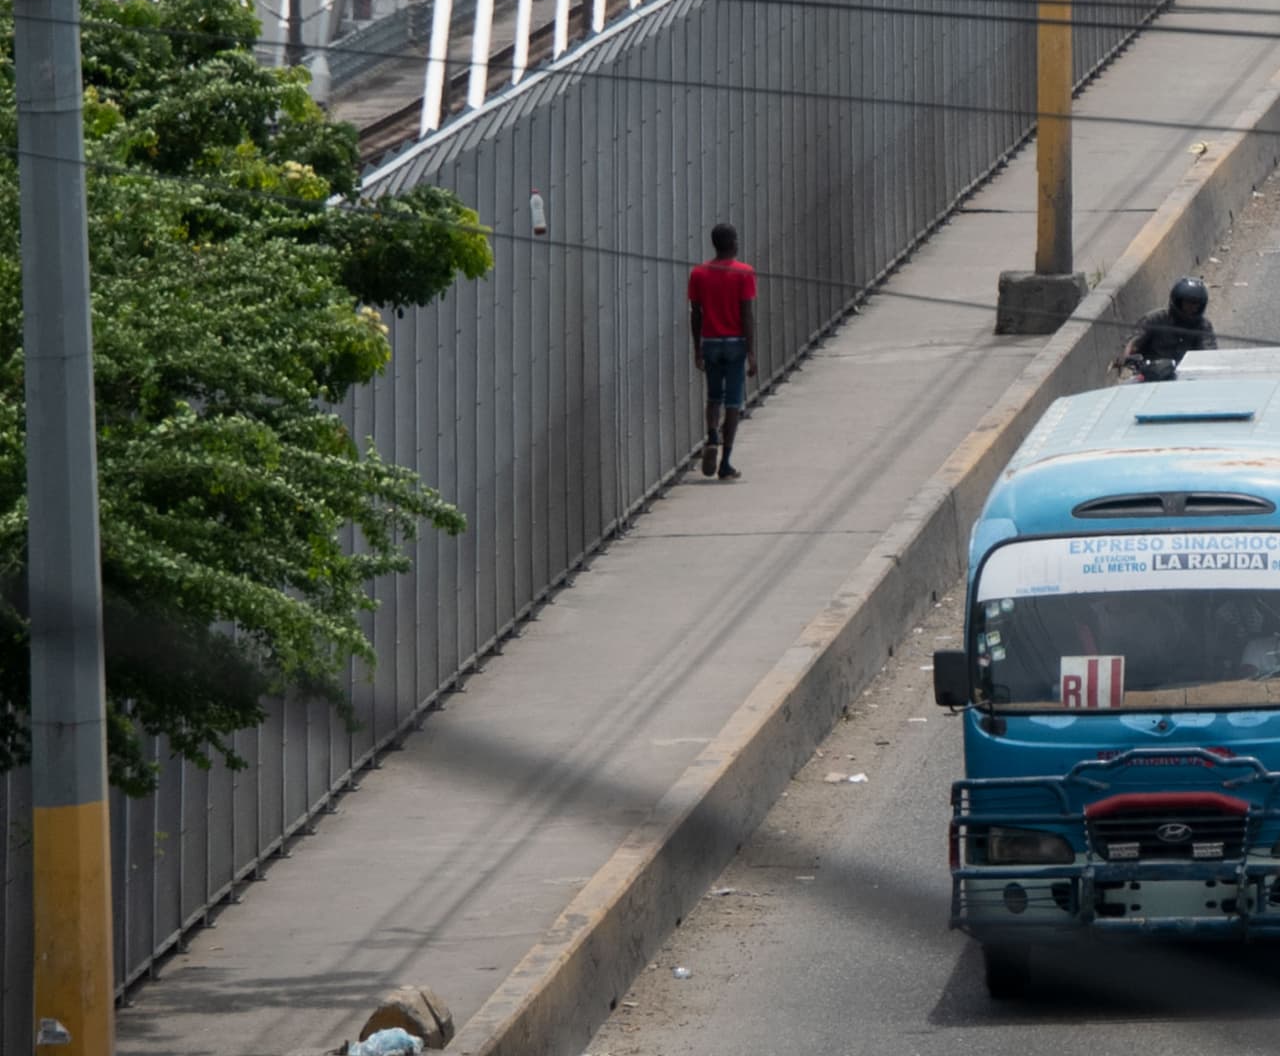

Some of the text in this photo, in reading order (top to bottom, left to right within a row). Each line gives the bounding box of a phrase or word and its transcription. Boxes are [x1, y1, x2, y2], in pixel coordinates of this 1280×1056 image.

[1069, 536, 1165, 555] EXPRESO
[1094, 554, 1137, 564] ESTACION
[1155, 553, 1264, 570] LA RAPIDA
[1082, 562, 1147, 574] DEL METRO
